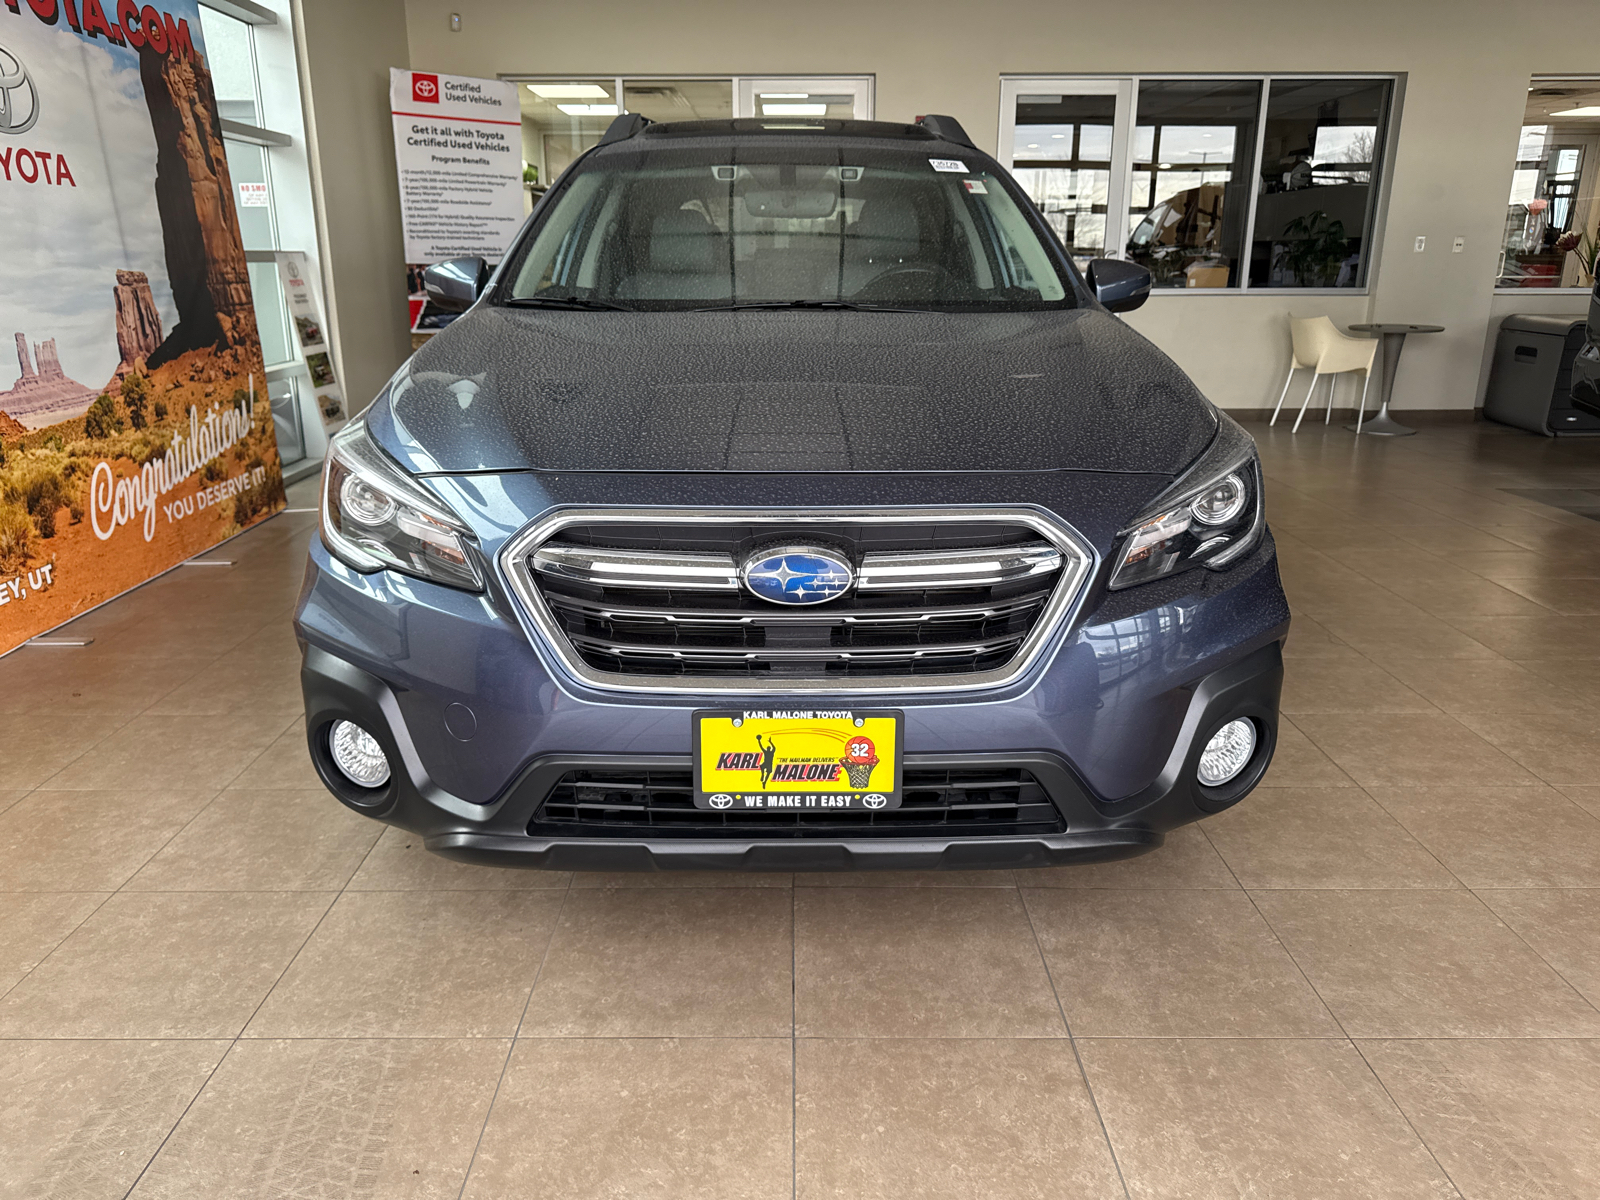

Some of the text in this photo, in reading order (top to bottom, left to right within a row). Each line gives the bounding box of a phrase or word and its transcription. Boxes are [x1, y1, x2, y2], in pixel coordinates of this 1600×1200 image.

[4, 0, 196, 64] TA.COM
[445, 81, 481, 93] Certified
[445, 93, 502, 106] Used Vehicles
[412, 125, 504, 141] Get it all with Toyota
[407, 137, 510, 152] Certified Used Vehicles
[431, 155, 490, 165] Program Benefits
[90, 373, 255, 542] Congratulations!
[163, 465, 266, 523] YOU DESERVE IT!
[28, 563, 52, 590] UT
[743, 711, 852, 719] KARL MALONE TOYOTA
[851, 743, 869, 757] 32
[716, 753, 761, 769] KARL
[771, 764, 841, 781] MALONE
[744, 796, 851, 807] WE MAKE IT EASY
